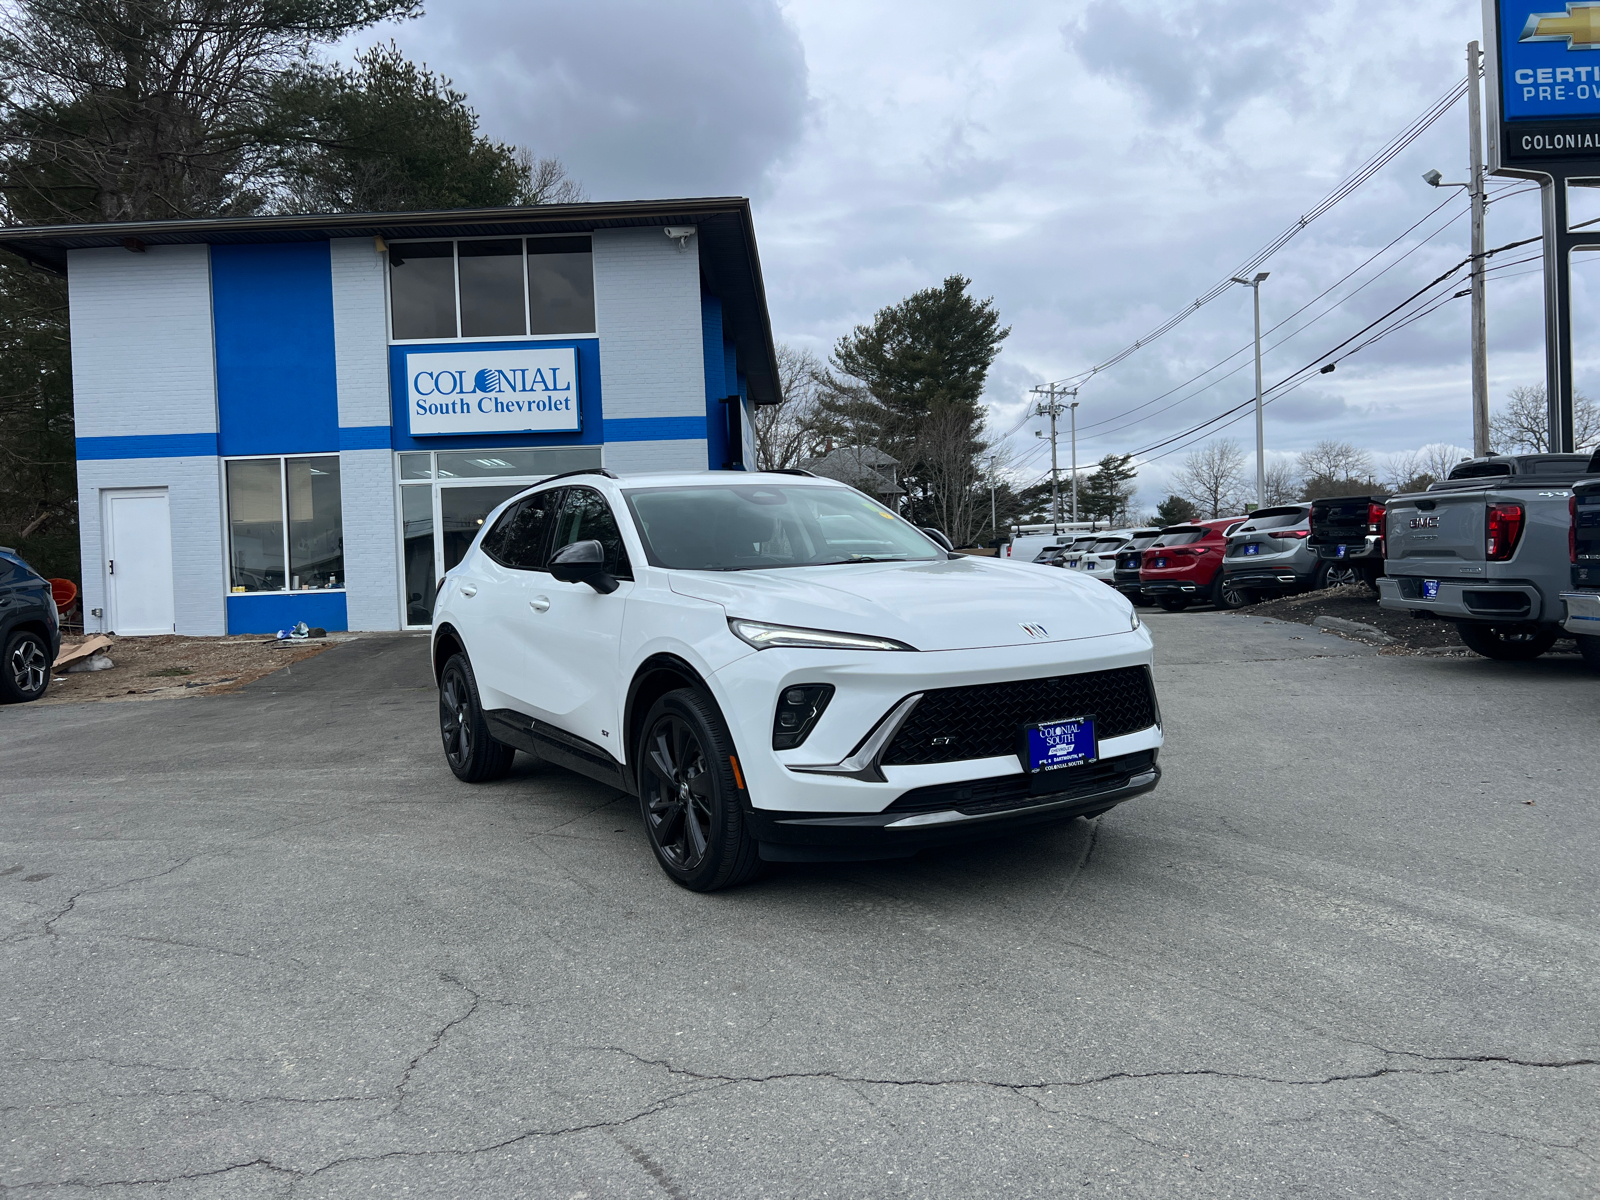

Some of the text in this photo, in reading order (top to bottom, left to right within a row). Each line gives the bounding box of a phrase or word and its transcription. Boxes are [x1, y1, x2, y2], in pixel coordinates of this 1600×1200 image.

[1521, 133, 1600, 150] COLONIAL
[413, 367, 571, 396] COLONIAL
[416, 395, 571, 416] South Chevrolet
[1409, 516, 1440, 529] GMC
[1040, 724, 1080, 738] COLONIAL
[1046, 734, 1074, 746] SOUTH
